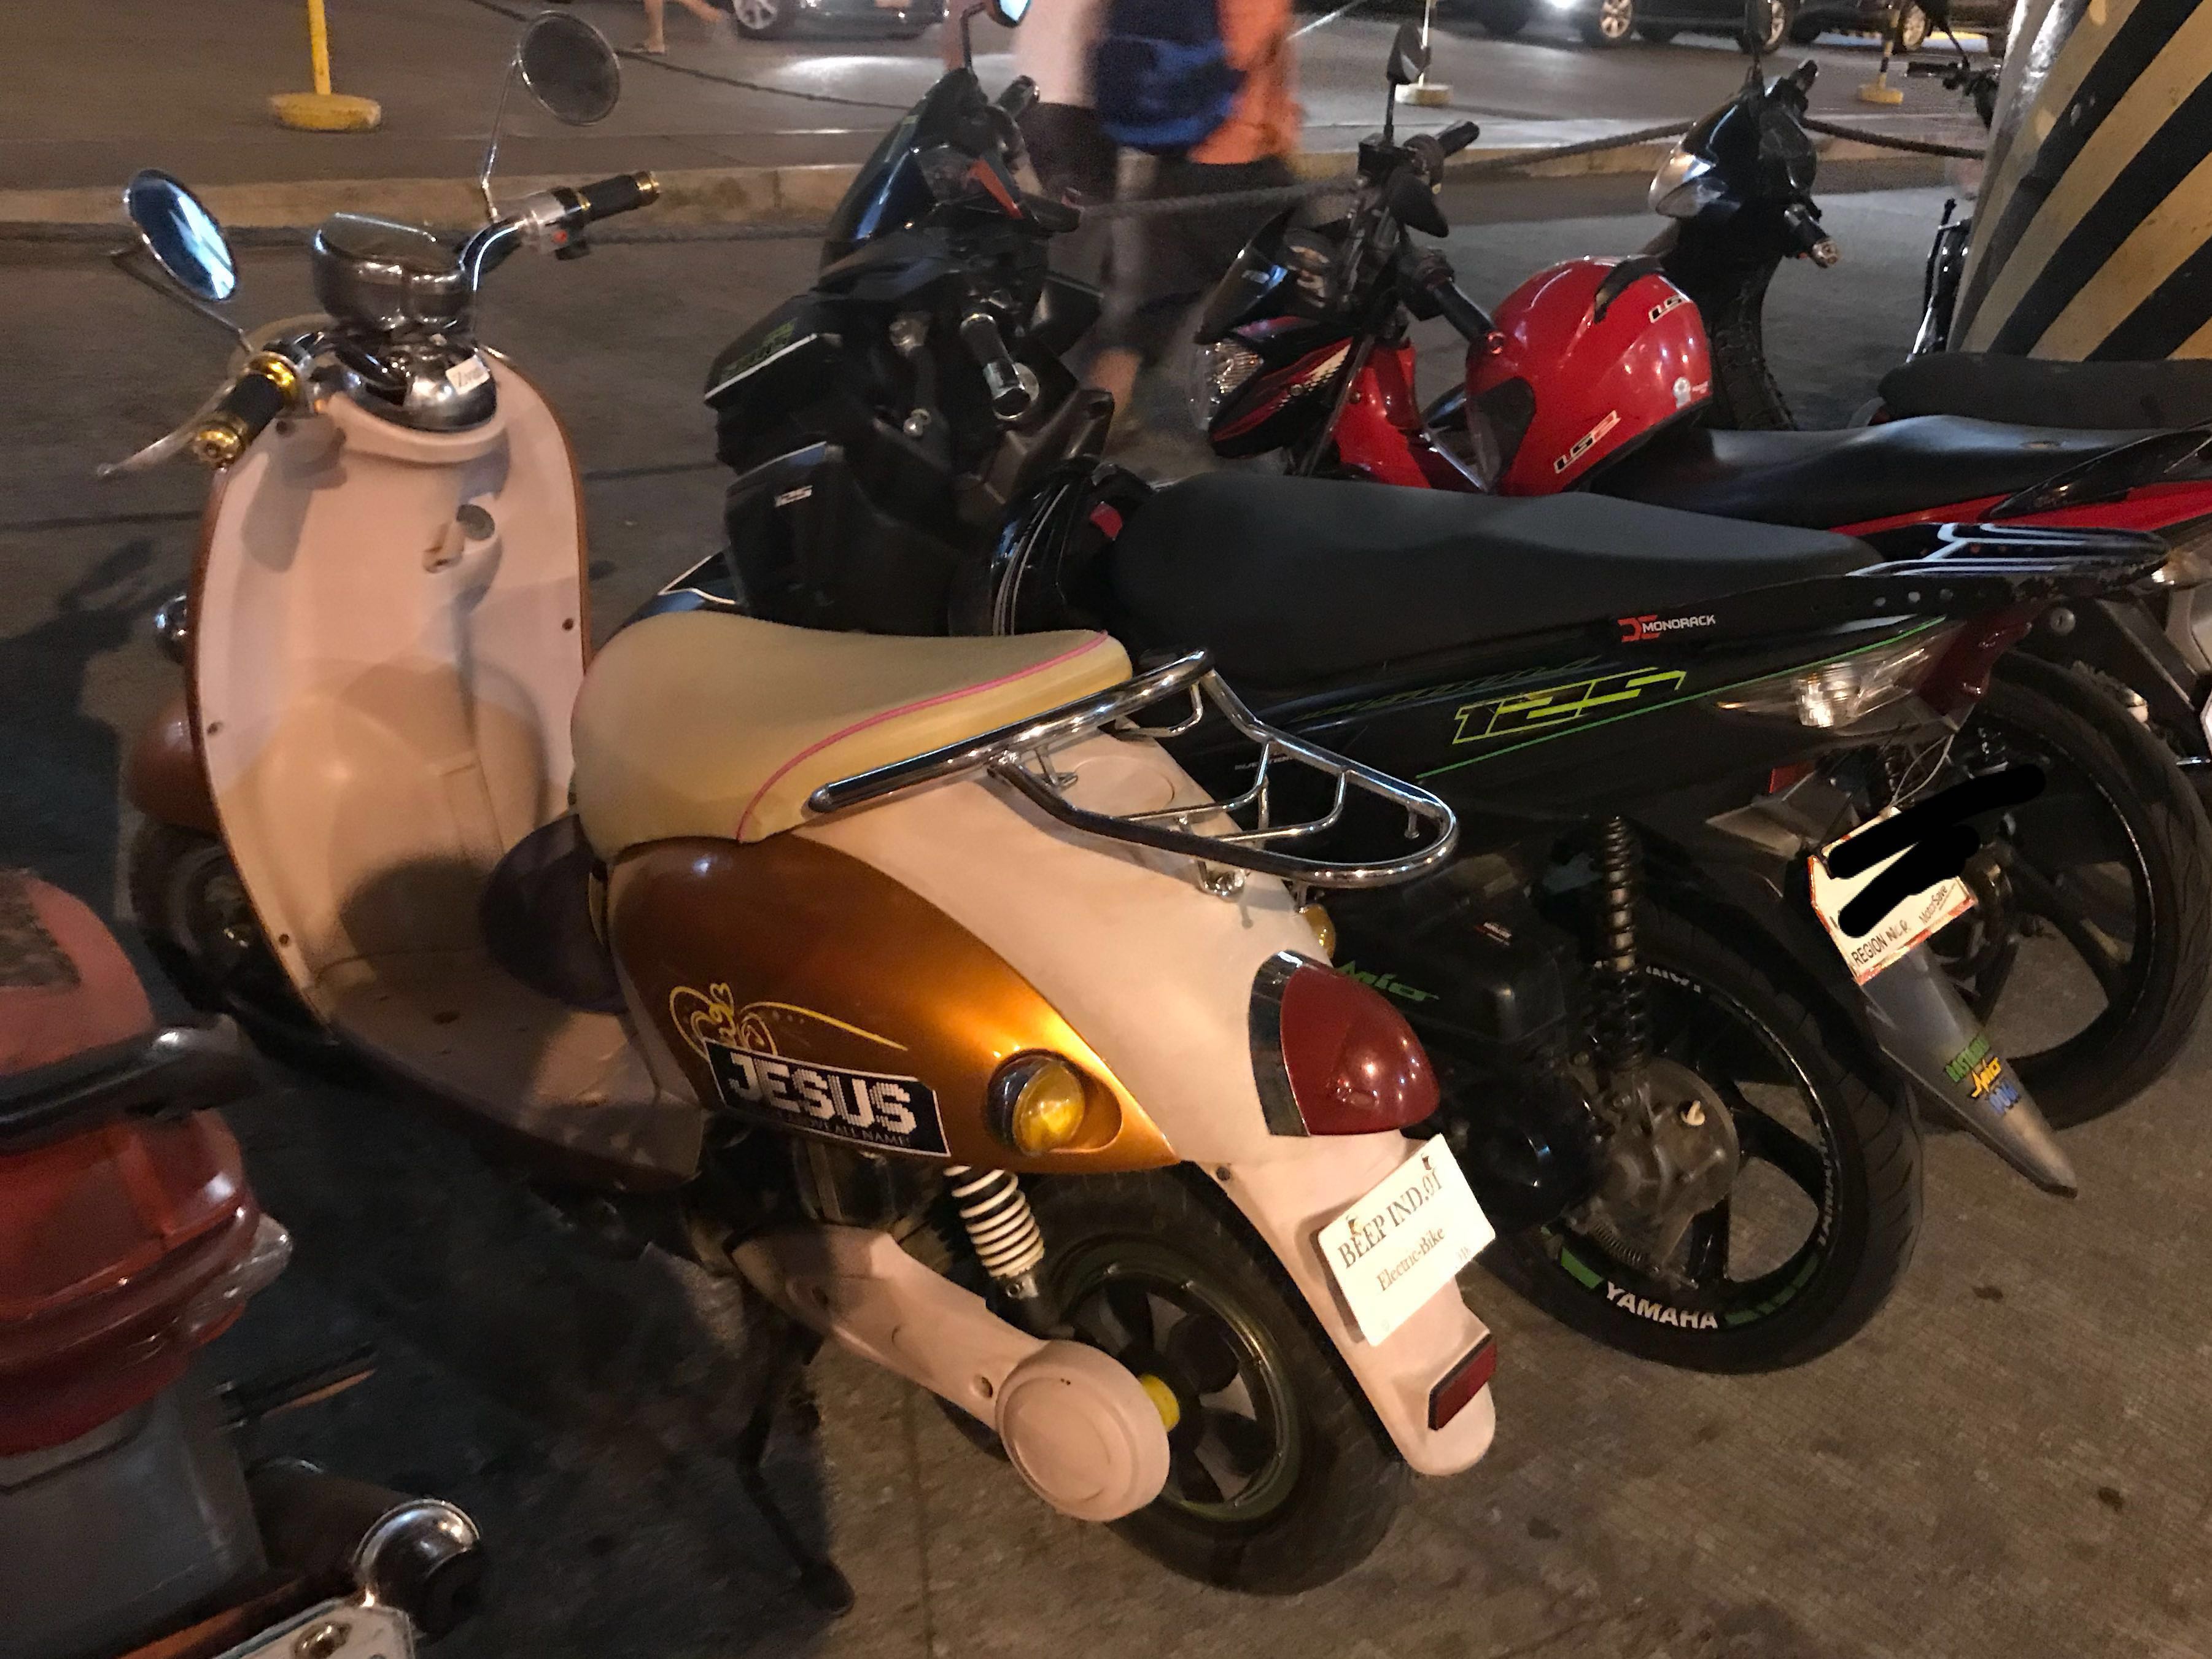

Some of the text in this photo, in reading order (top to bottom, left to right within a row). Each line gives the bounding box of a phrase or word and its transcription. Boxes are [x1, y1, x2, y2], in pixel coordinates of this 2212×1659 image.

[1648, 294, 1690, 323] LS
[1553, 410, 1621, 474] LS2
[1642, 614, 1717, 633] MONORACK
[1850, 933, 1888, 967] REGION
[728, 1051, 917, 1135] JESUS
[1337, 1214, 1386, 1269] BEEP
[1376, 1228, 1445, 1291] Electric-Bike
[1606, 1281, 1718, 1330] YAMAHA
